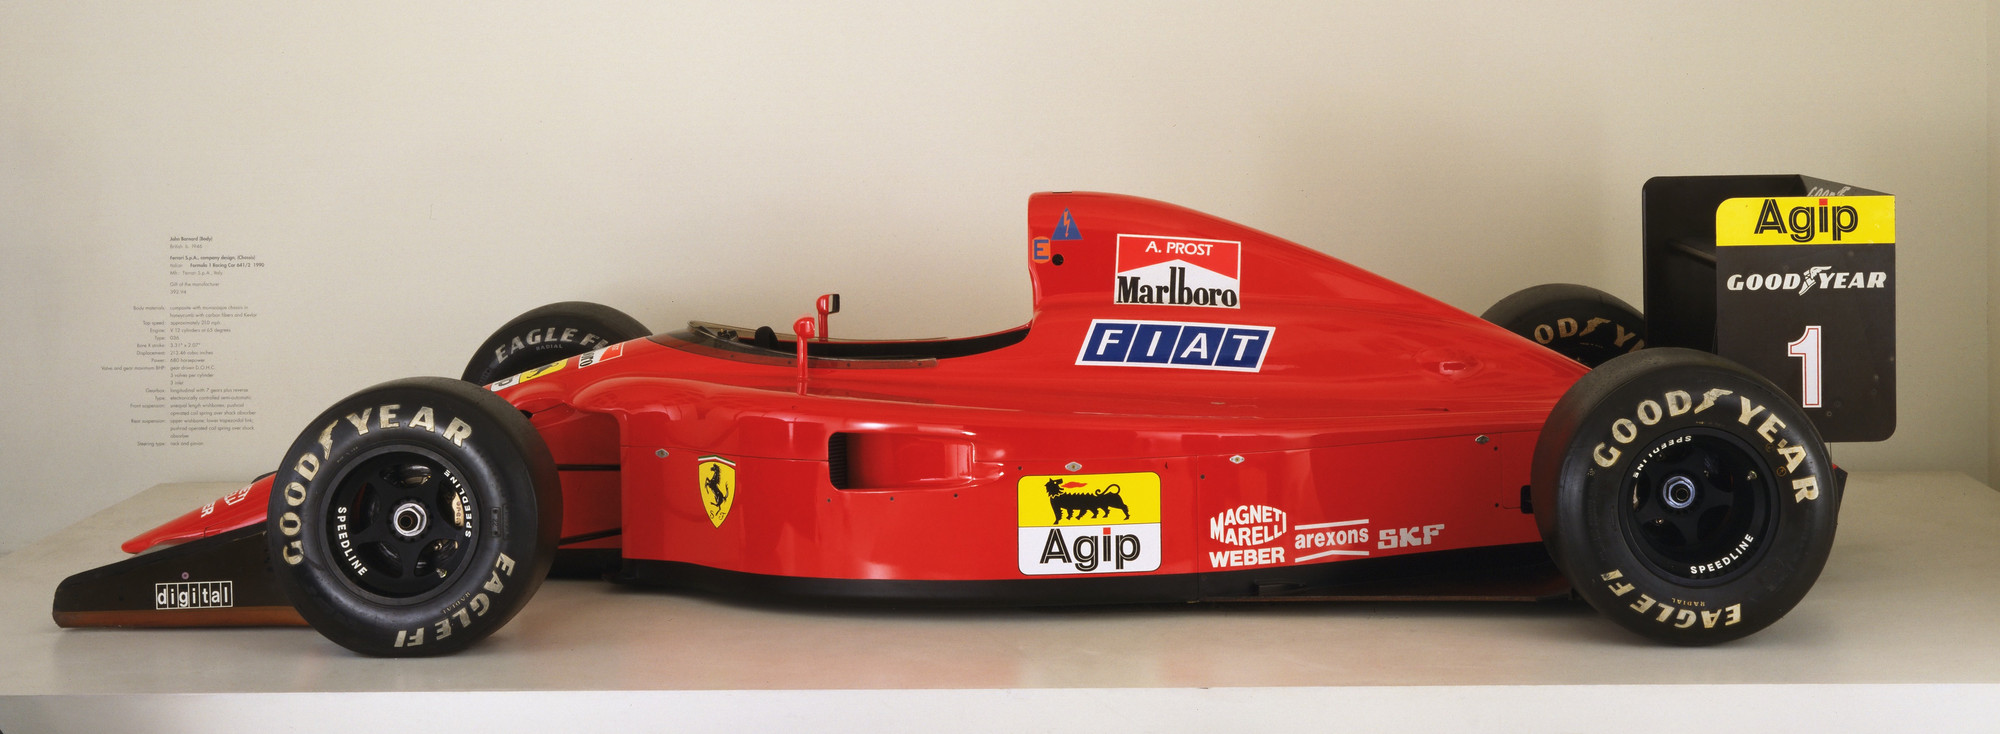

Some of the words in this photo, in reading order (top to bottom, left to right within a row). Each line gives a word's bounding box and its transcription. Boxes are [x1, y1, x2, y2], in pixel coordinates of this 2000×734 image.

[1753, 198, 1859, 243] Agip
[1144, 240, 1163, 254] A.
[1165, 241, 1214, 257] PROST
[1115, 266, 1238, 308] Marlboro
[494, 327, 579, 364] EAGLE
[1095, 327, 1261, 362] FIAT
[1787, 325, 1822, 408] 1
[443, 469, 473, 538] SPEEDLINE
[1210, 505, 1287, 528] MAGNETI
[337, 506, 368, 577] SPEEDLINE
[1039, 527, 1142, 572] Agip
[1210, 520, 1287, 546] MARELLI
[1294, 527, 1370, 550] arexons
[1377, 523, 1446, 550] SKF
[1208, 546, 1286, 568] WEBER
[1690, 533, 1754, 575] SPEEDLINE
[157, 586, 229, 608] digital
[434, 552, 516, 641] EAGLE
[1629, 593, 1741, 629] EAGLE
